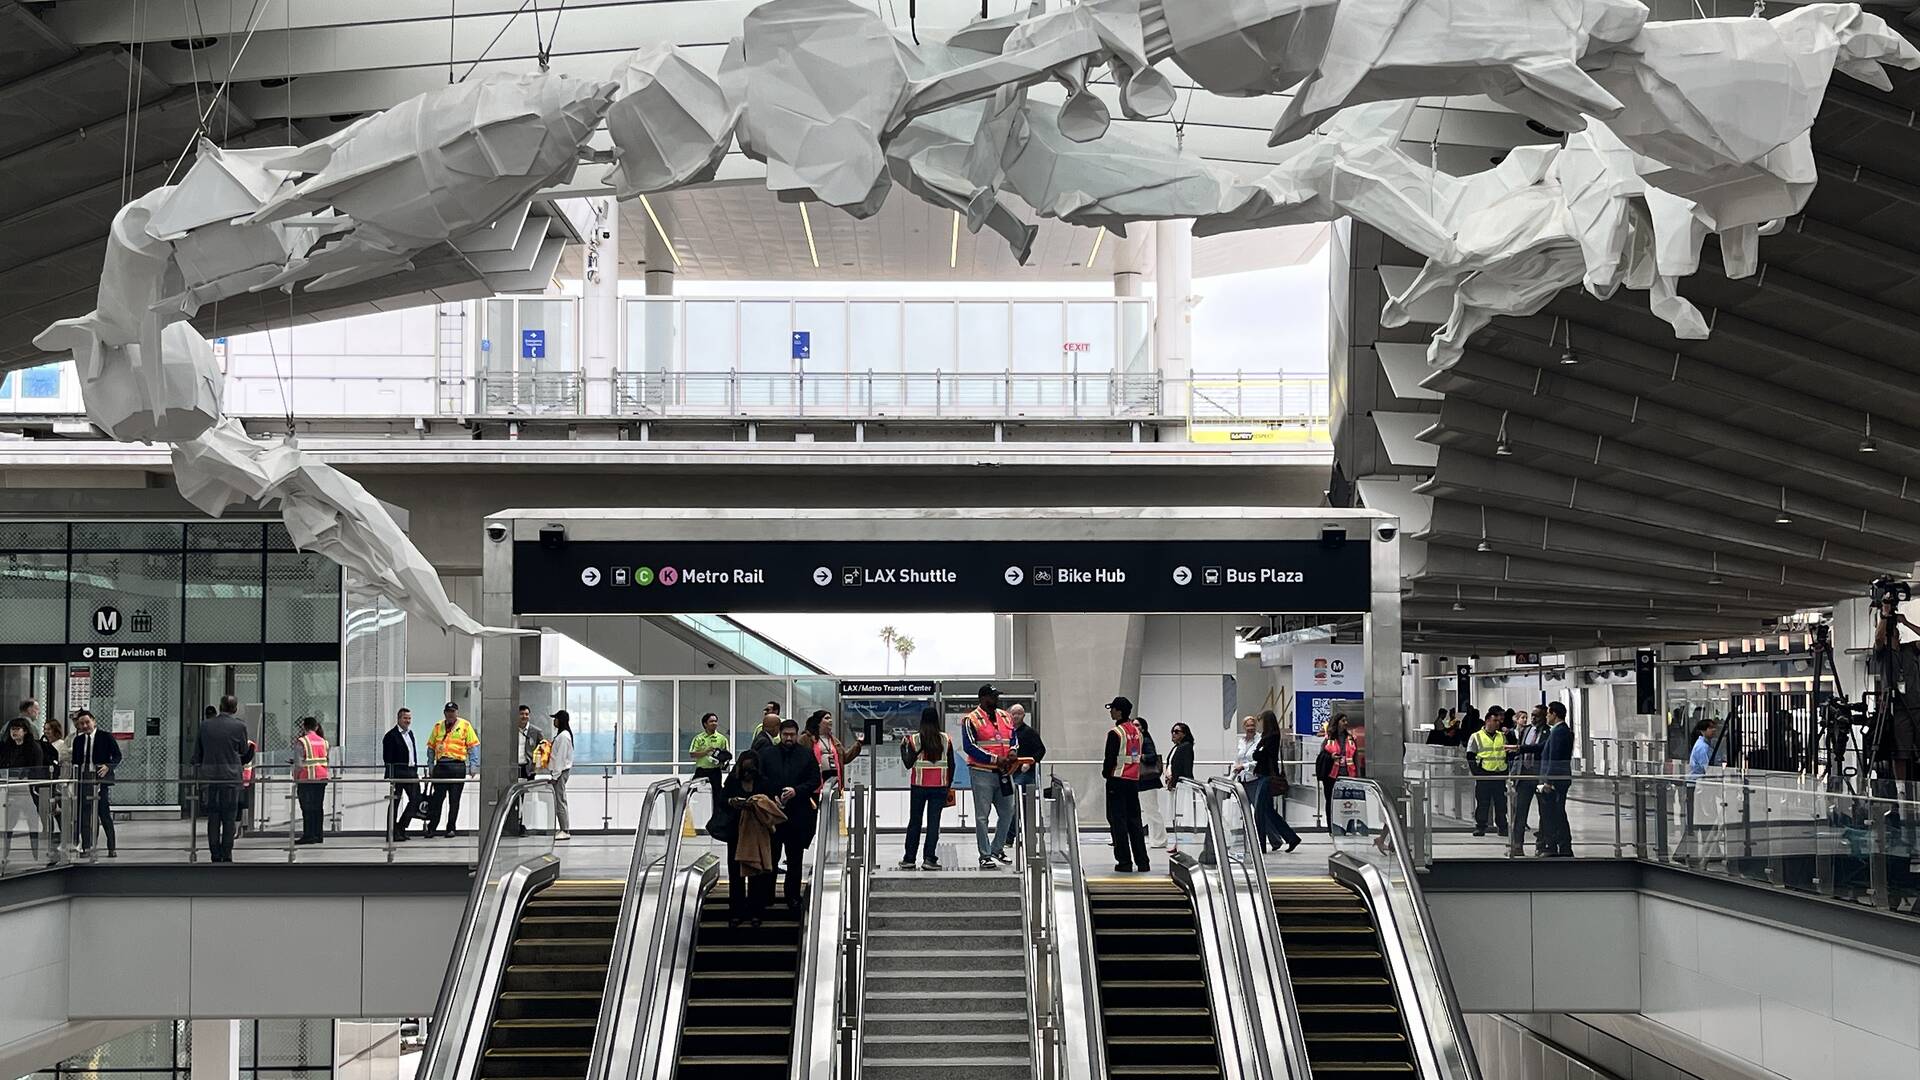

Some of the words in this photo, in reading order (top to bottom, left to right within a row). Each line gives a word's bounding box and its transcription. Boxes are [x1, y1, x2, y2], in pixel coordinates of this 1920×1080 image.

[1069, 343, 1089, 351] EXIT
[682, 568, 729, 584] Metro
[733, 568, 765, 584] Rail
[864, 568, 896, 583] LAX
[900, 568, 957, 583] Shuttle
[1057, 568, 1092, 583] Bike
[1095, 568, 1126, 583] Hub
[1226, 568, 1257, 583] Bus
[1260, 568, 1304, 583] Plaza
[100, 648, 118, 657] Exit
[121, 648, 156, 657] Aviation
[157, 648, 167, 657] Bl
[843, 684, 882, 692] LAX/Metro
[883, 684, 907, 692] Transit
[908, 684, 932, 692] Center
